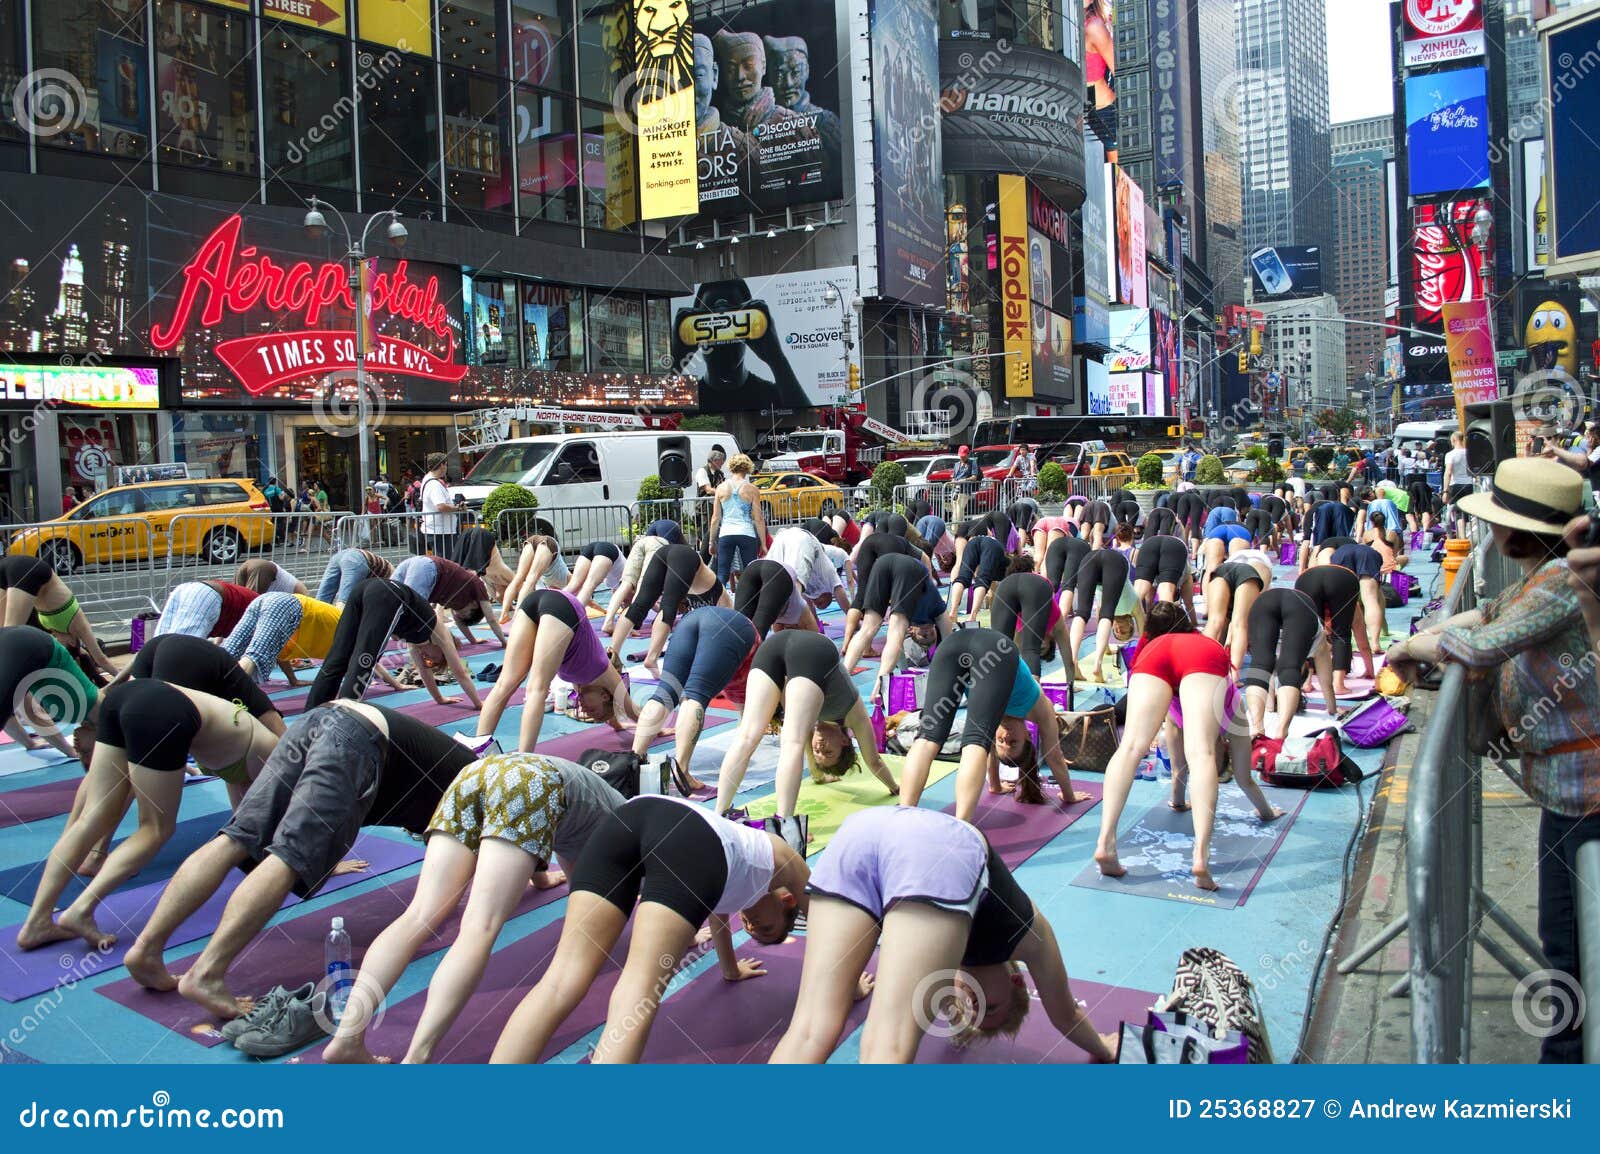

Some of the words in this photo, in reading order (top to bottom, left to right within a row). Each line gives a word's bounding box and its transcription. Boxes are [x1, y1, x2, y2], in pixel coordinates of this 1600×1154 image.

[265, 0, 312, 17] STREET
[1421, 38, 1467, 53] XINHUA
[1411, 51, 1437, 62] NEWS
[1439, 46, 1478, 58] AGENCY
[1155, 30, 1176, 155] SQUARE
[643, 120, 691, 134] MINSKOFF
[646, 129, 688, 142] THEATRE
[760, 146, 774, 155] ONE
[775, 142, 797, 152] BLOCK
[797, 137, 820, 147] SOUTH
[650, 160, 672, 169] 45TH
[646, 178, 690, 189] lionking.com
[151, 214, 453, 349] Aéropstale
[1003, 236, 1029, 341] Kodak
[694, 312, 751, 341] SPY
[1449, 317, 1488, 329] SOLSTICE
[790, 331, 843, 344] Discover
[257, 340, 326, 375] TIMES
[334, 338, 398, 366] SQARE
[1451, 358, 1492, 367] ATHLETA
[1453, 369, 1472, 378] MIND
[1473, 367, 1493, 376] OVER
[1454, 378, 1495, 390] MADNESS
[1457, 390, 1497, 406] YOGA
[536, 411, 560, 421] NORTH
[562, 413, 586, 422] SHORE
[587, 415, 606, 423] NEON
[607, 416, 623, 424] SIGN
[1167, 892, 1216, 904] LUNA
